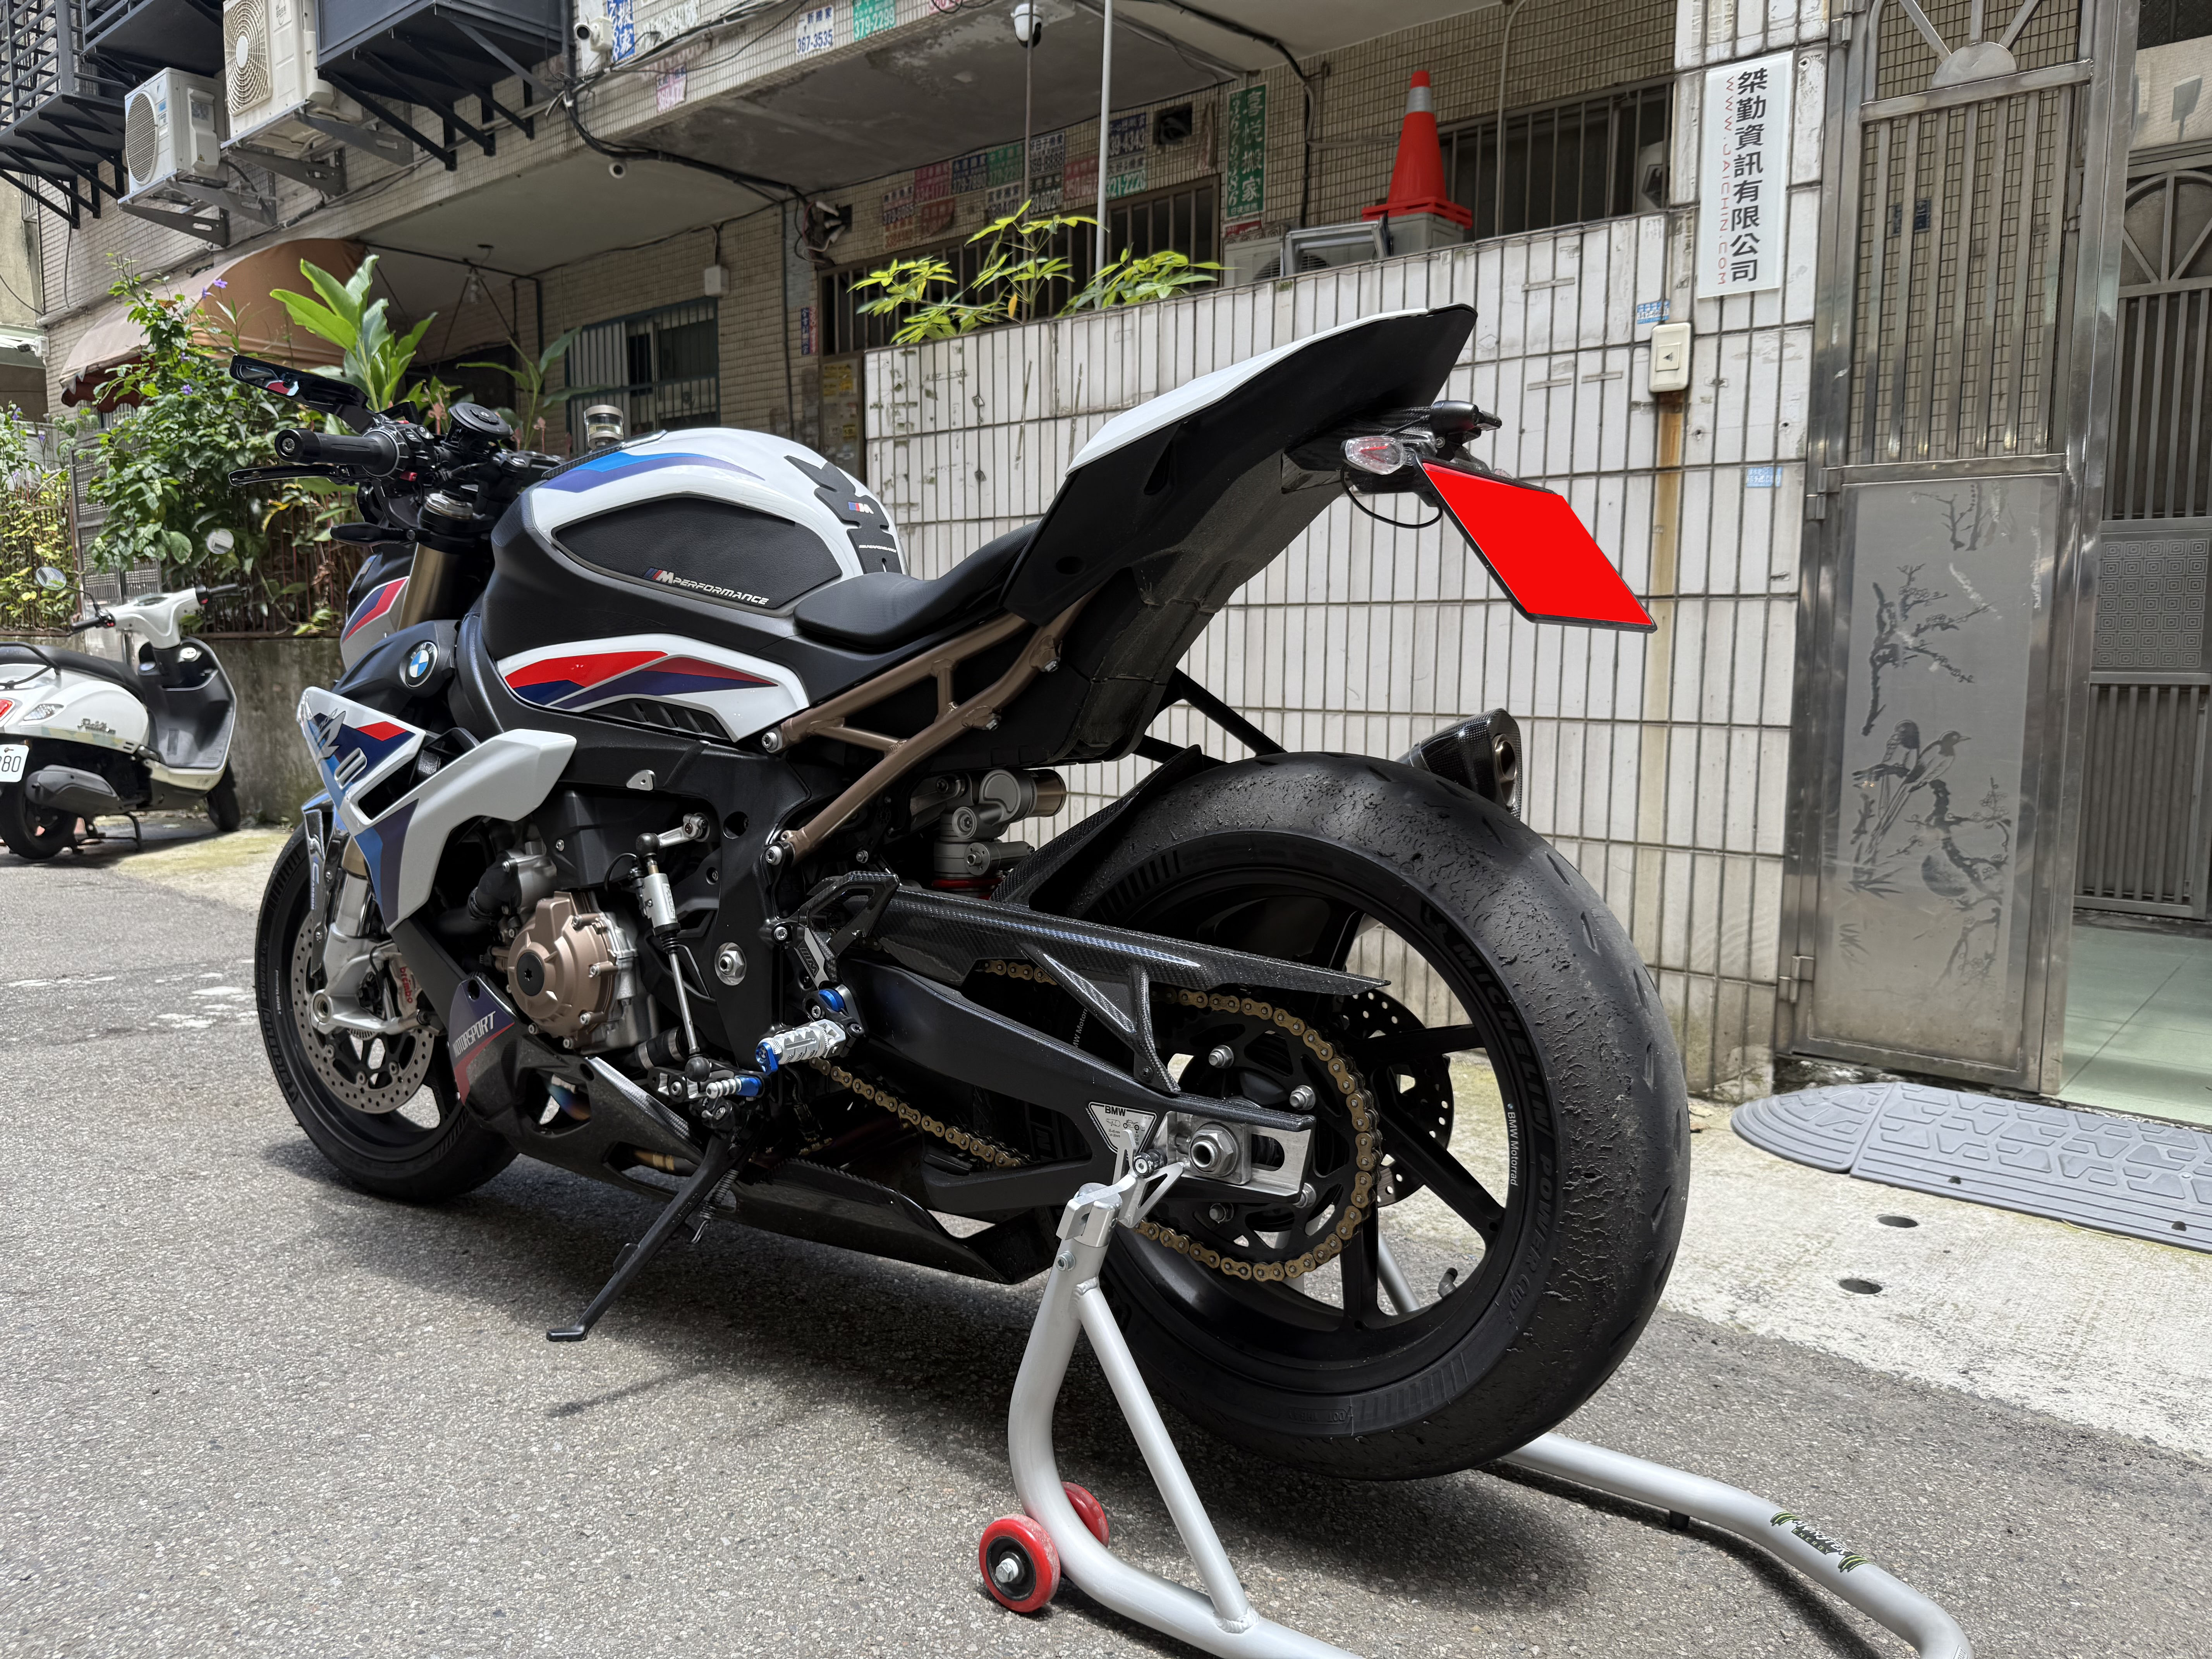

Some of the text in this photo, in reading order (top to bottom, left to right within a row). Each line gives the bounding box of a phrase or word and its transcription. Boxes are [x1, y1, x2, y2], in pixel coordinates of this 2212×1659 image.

[799, 6, 833, 24] 一新搬家
[854, 7, 895, 38] 379-2299
[797, 29, 833, 54] 367-3535
[1109, 127, 1145, 156] 39-4343
[1228, 100, 1239, 207] 3679386
[1718, 76, 1734, 285] WWW.JAICHIN.COM
[1730, 67, 1768, 282] 桀勤資訊有限公司
[410, 643, 434, 659] BMW
[0, 756, 22, 772] 80
[400, 966, 413, 1004] brembo
[452, 1011, 496, 1058] MOTORSPORT
[1453, 943, 1552, 1130] MICHELIN
[1104, 1105, 1126, 1116] BMW
[1507, 1112, 1519, 1186] BMW Motorrad
[1792, 1529, 1831, 1554] ENERGY
[1793, 1520, 1850, 1555] MONSTER
